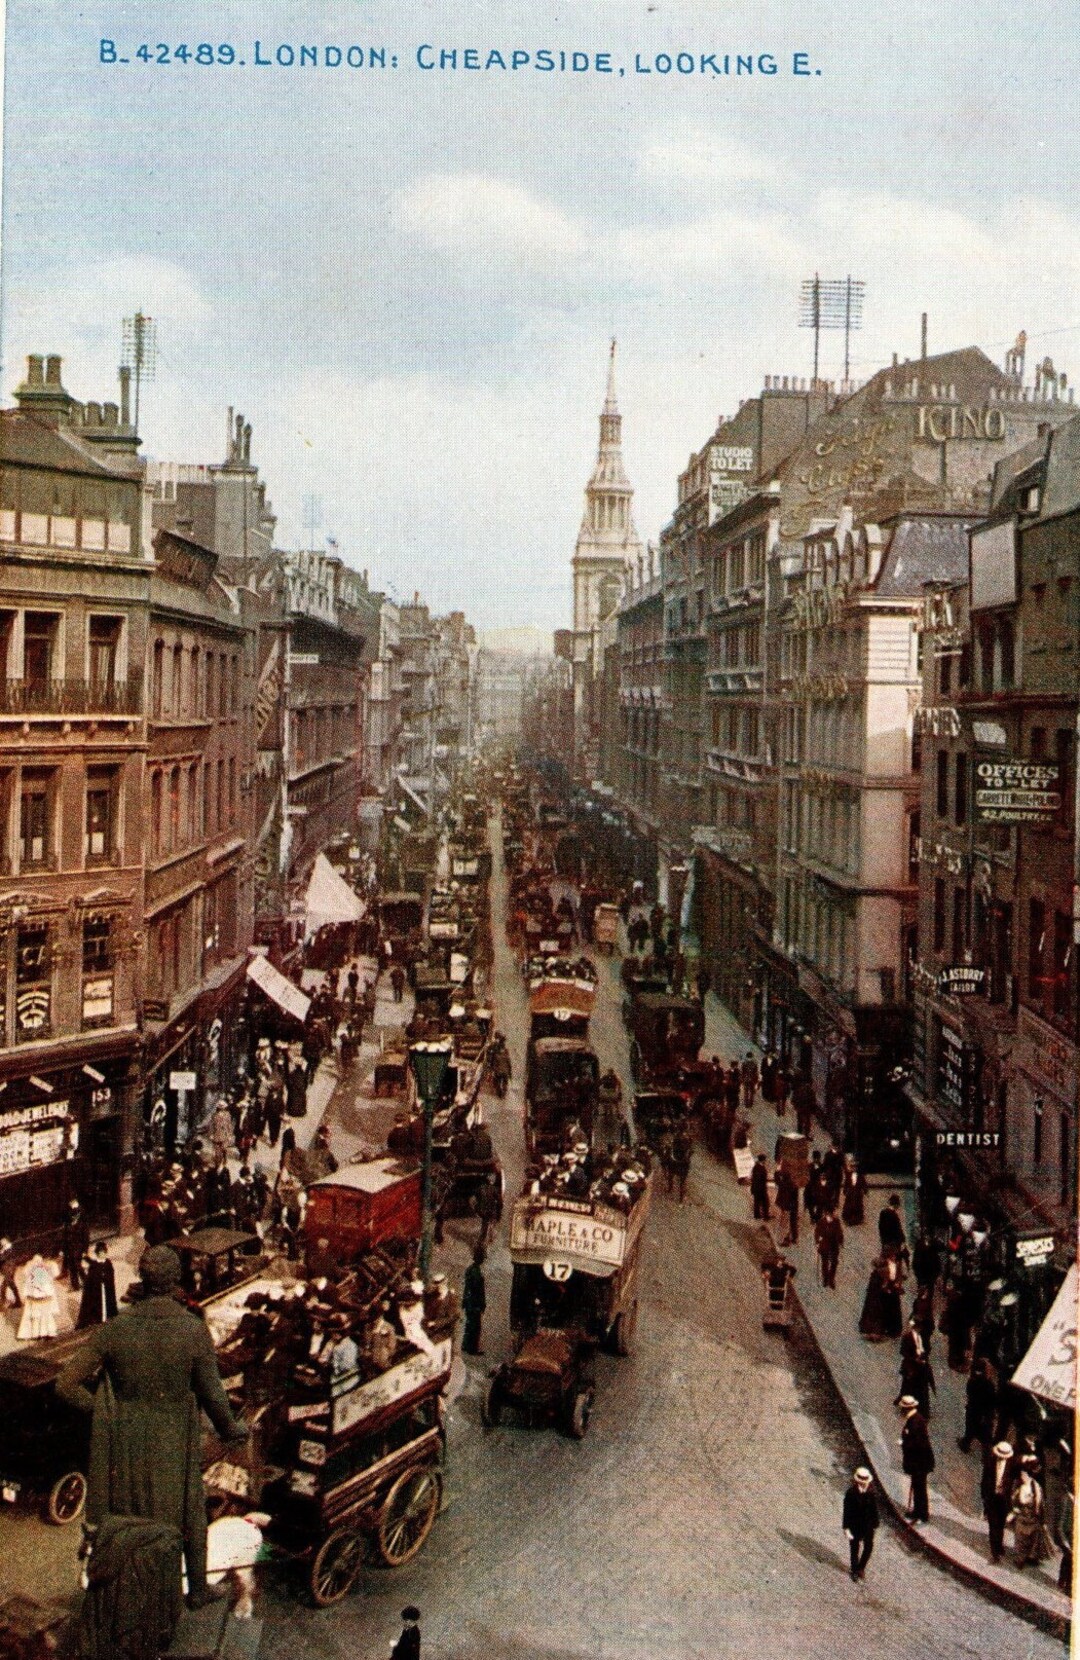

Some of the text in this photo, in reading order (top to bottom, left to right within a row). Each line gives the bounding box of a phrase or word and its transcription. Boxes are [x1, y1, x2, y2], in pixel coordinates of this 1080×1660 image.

[977, 763, 1060, 780] OFFICES
[984, 777, 1005, 788] TO
[1020, 778, 1051, 789] LET
[91, 1086, 112, 1108] 153
[936, 1132, 1000, 1146] DENTIST
[592, 1225, 614, 1243] CO
[550, 1263, 570, 1279] 17
